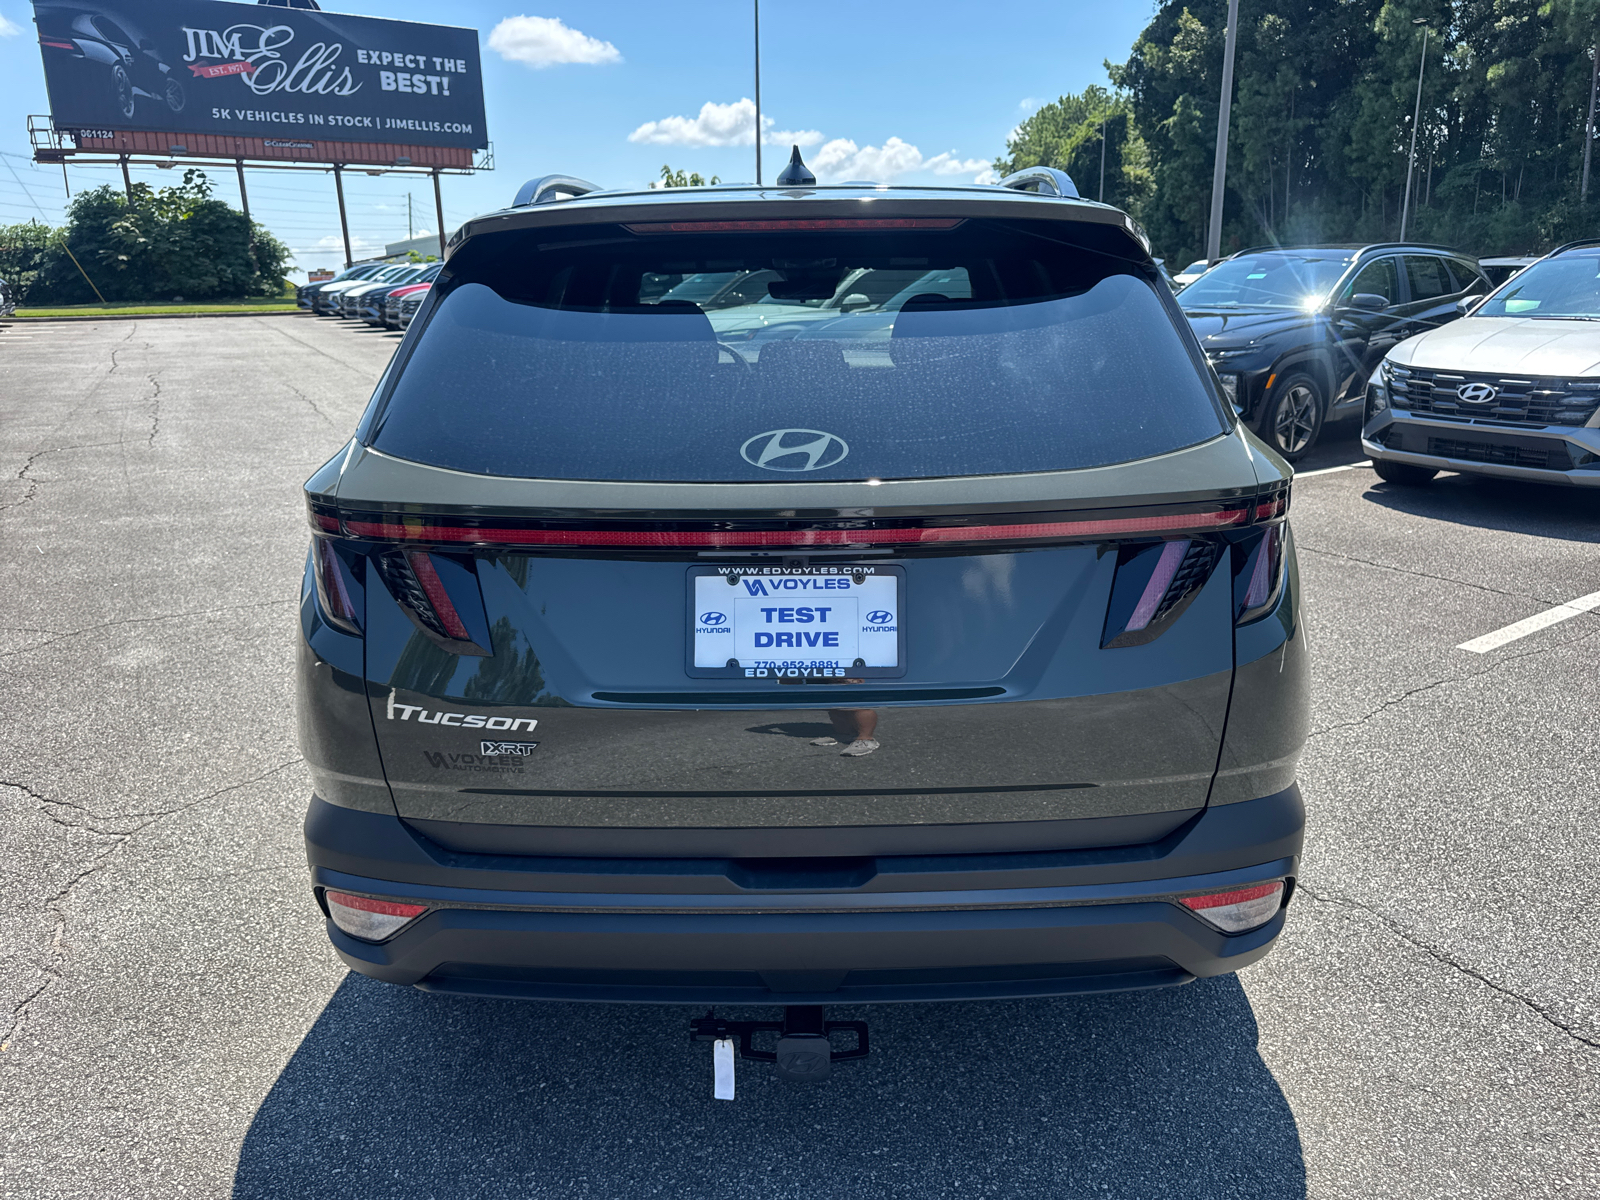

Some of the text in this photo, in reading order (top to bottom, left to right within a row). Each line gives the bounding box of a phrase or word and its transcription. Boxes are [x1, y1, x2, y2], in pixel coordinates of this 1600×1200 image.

[183, 24, 363, 95] JIM Ellis
[357, 49, 467, 73] EXPECT THE
[209, 66, 227, 76] EST.
[380, 71, 450, 96] BEST!
[212, 108, 231, 120] 5K
[235, 109, 305, 124] VEHICLES
[309, 114, 324, 125] IN
[328, 115, 373, 128] STOCK
[385, 118, 473, 134] JIMELLIS.COM
[80, 129, 114, 139] 061124
[718, 567, 875, 575] WWW.EDVOYLES.COM
[768, 578, 851, 590] VOYLES
[760, 607, 832, 623] TEST
[754, 632, 839, 648] DRIVE
[754, 660, 839, 668] 770-952-8881
[745, 668, 846, 678] ED VOYLES
[448, 753, 524, 767] VOYLES
[452, 764, 525, 774] AUTOMOTIVE
